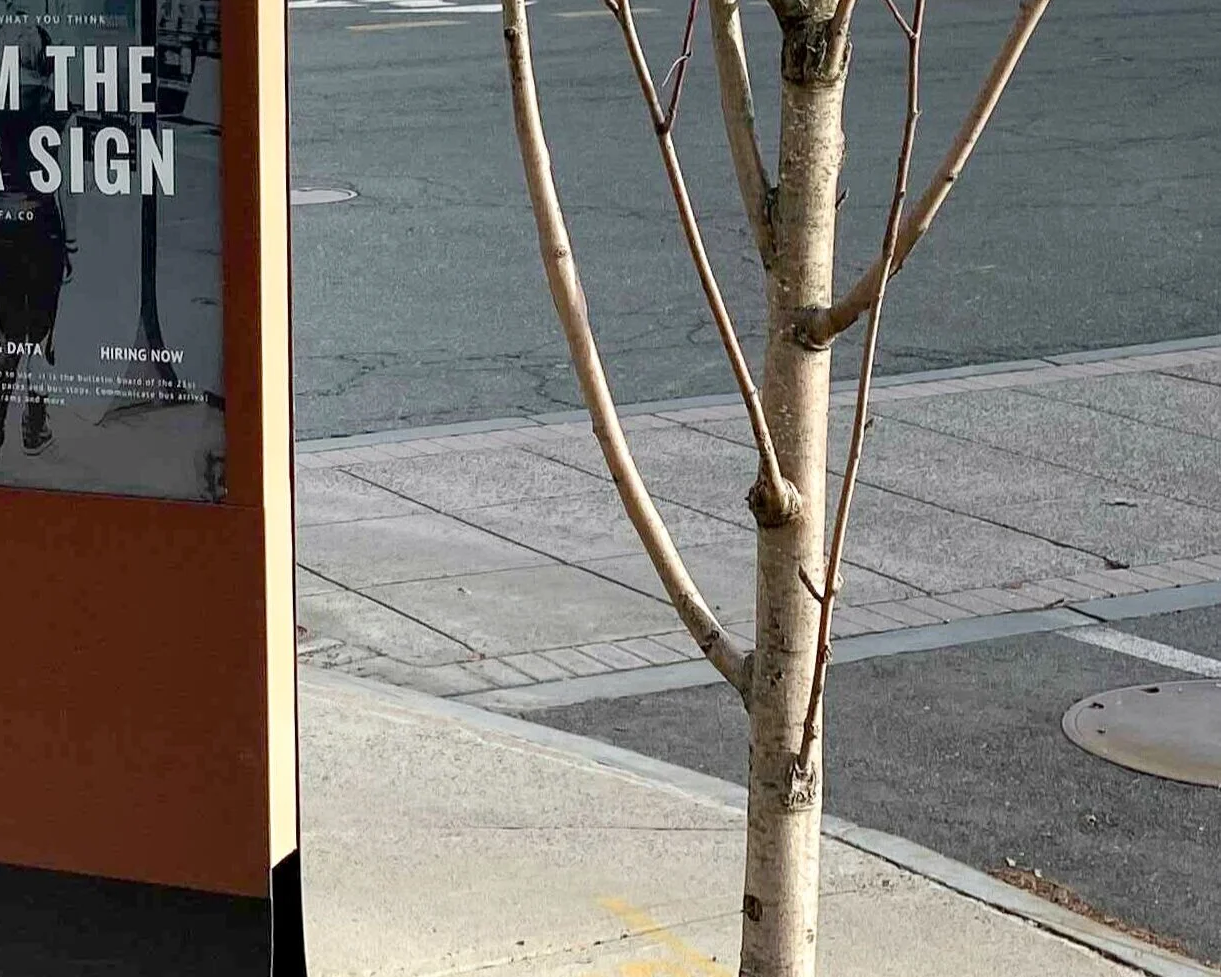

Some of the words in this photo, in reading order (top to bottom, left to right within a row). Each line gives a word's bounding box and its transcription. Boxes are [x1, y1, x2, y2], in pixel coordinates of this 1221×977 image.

[35, 14, 60, 24] YOU
[67, 14, 106, 25] THINK
[45, 45, 157, 113] THE
[29, 125, 176, 196] SIGN
[7, 341, 43, 356] DATA
[100, 346, 147, 362] HIRING
[151, 348, 184, 364] NOW
[60, 373, 75, 382] the
[78, 373, 113, 385] bulletin
[117, 376, 142, 386] board
[158, 378, 173, 388] the
[24, 395, 41, 404] and
